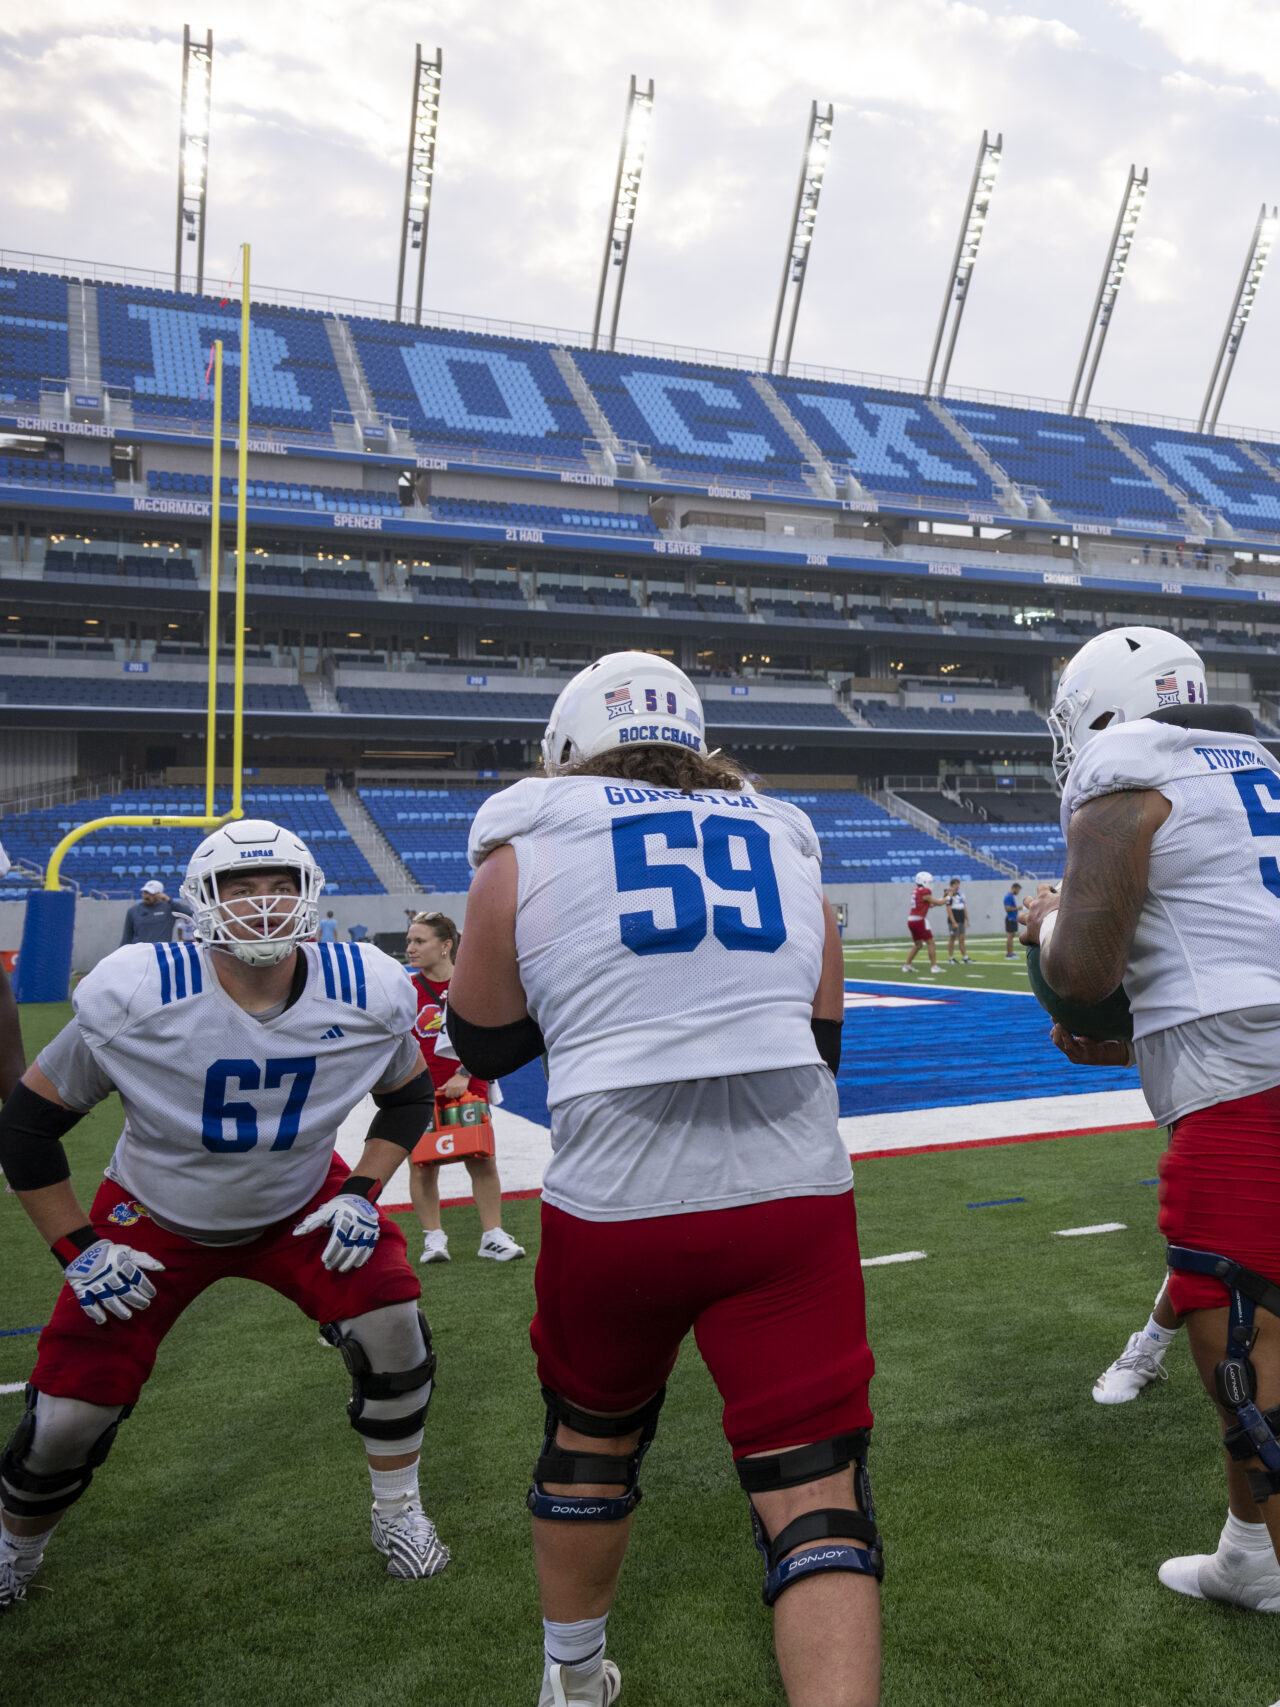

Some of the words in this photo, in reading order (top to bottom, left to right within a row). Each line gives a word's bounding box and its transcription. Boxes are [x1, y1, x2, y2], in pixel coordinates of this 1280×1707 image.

[17, 416, 115, 438] SCHNELLBACHER
[235, 438, 288, 455] RKONIC
[416, 457, 448, 470] REICH
[560, 471, 614, 487] McCLINTON
[708, 485, 752, 501] DOUGLASS
[134, 498, 210, 517] McCORMACK
[333, 514, 382, 531] SPENCER
[505, 528, 518, 541] 21
[653, 541, 666, 553] 48
[667, 542, 702, 556] SAYERS
[806, 553, 828, 566] ZOOK
[928, 563, 962, 577] RIGGINS
[619, 726, 659, 743] ROCK
[661, 726, 702, 752] CHALK
[240, 849, 274, 859] KANSAS
[611, 811, 787, 956] 59
[201, 1055, 317, 1154] 67
[435, 1133, 455, 1155] G
[67, 1246, 103, 1273] adidas
[551, 1505, 608, 1516] DONJOY
[788, 1549, 848, 1572] DONJOY
